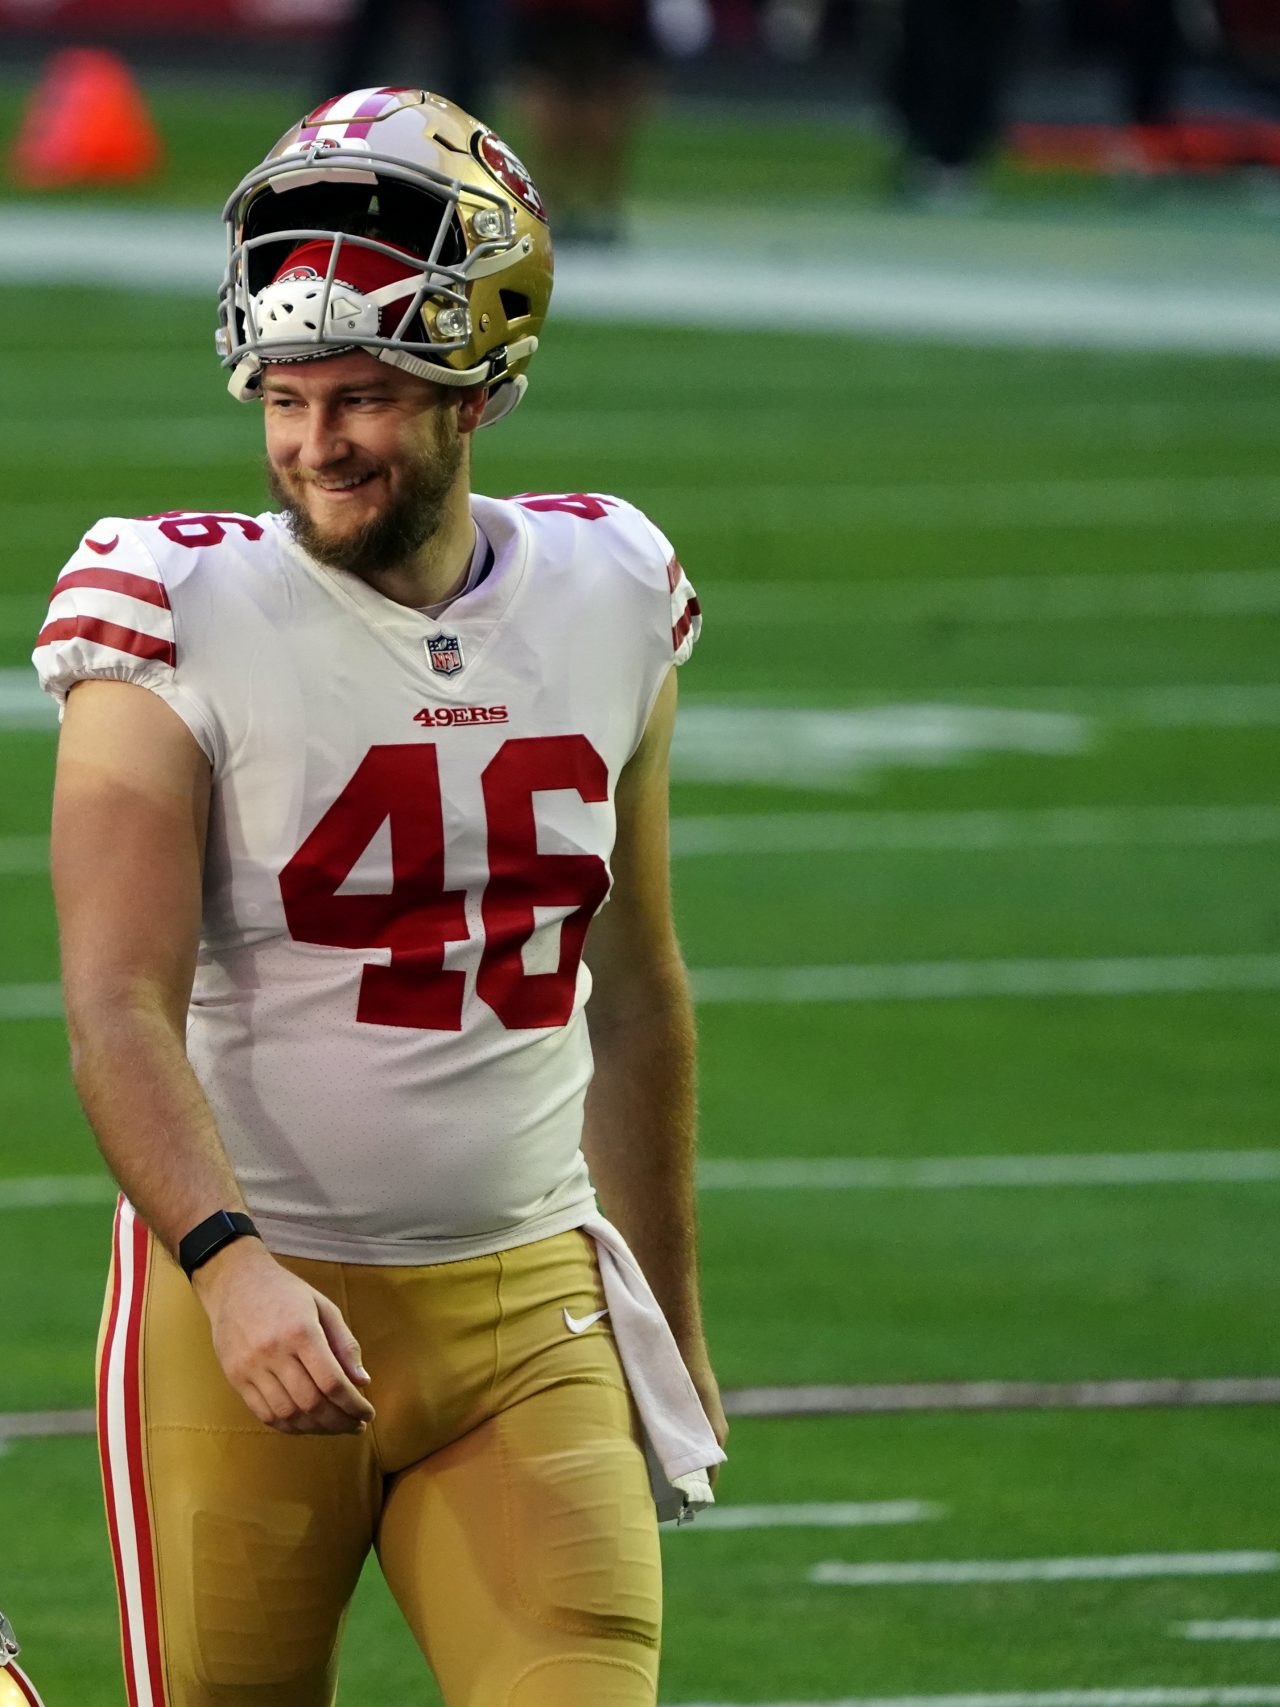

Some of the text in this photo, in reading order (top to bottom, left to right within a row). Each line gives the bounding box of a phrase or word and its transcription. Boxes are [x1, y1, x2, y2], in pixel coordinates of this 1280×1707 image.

[433, 651, 460, 670] NFL
[412, 705, 509, 727] 49ERS
[278, 733, 611, 1032] 46
